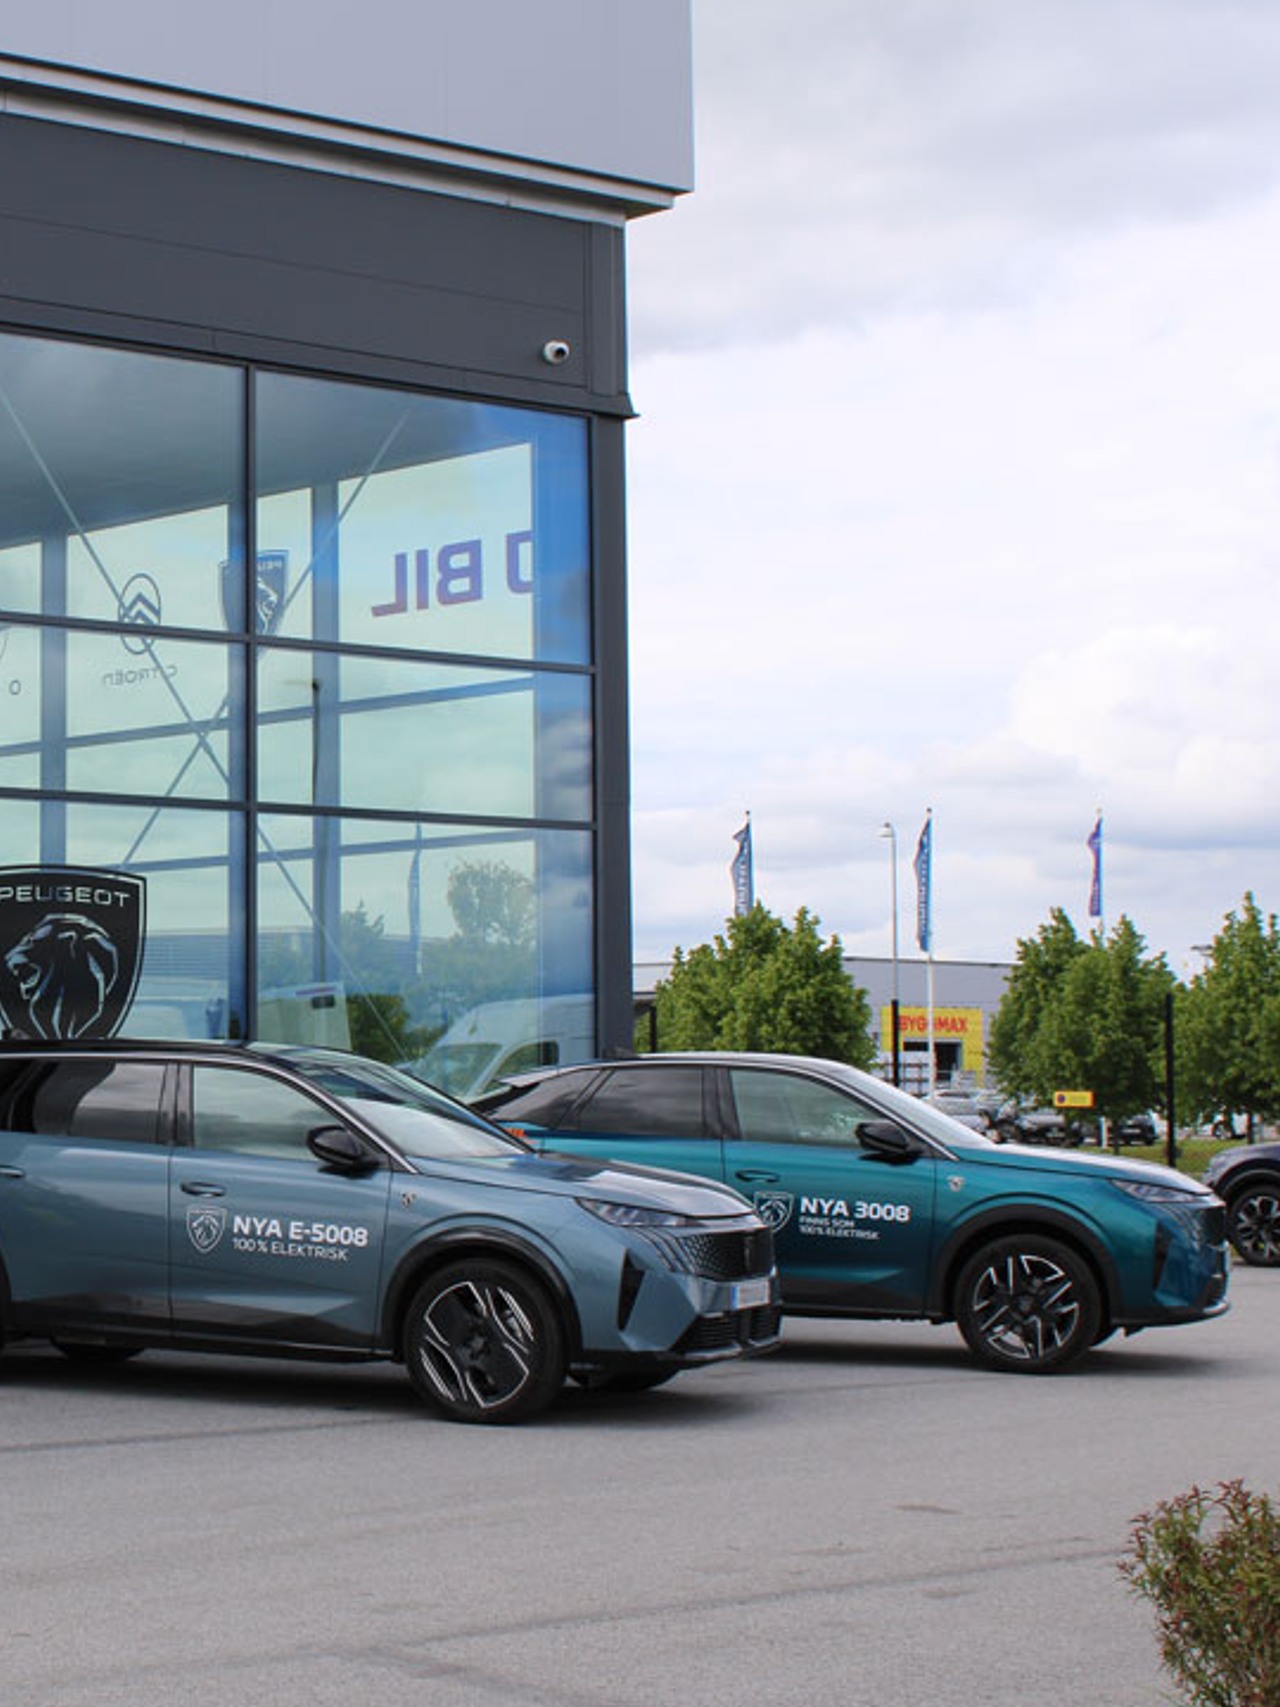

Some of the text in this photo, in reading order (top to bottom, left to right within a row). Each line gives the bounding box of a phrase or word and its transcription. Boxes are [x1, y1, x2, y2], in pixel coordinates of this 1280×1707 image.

[899, 1014, 968, 1033] BYGMAX
[800, 1198, 911, 1223] NYA 3008
[233, 1215, 369, 1247] NYA E-5008
[271, 1241, 350, 1261] ELEKTRISK
